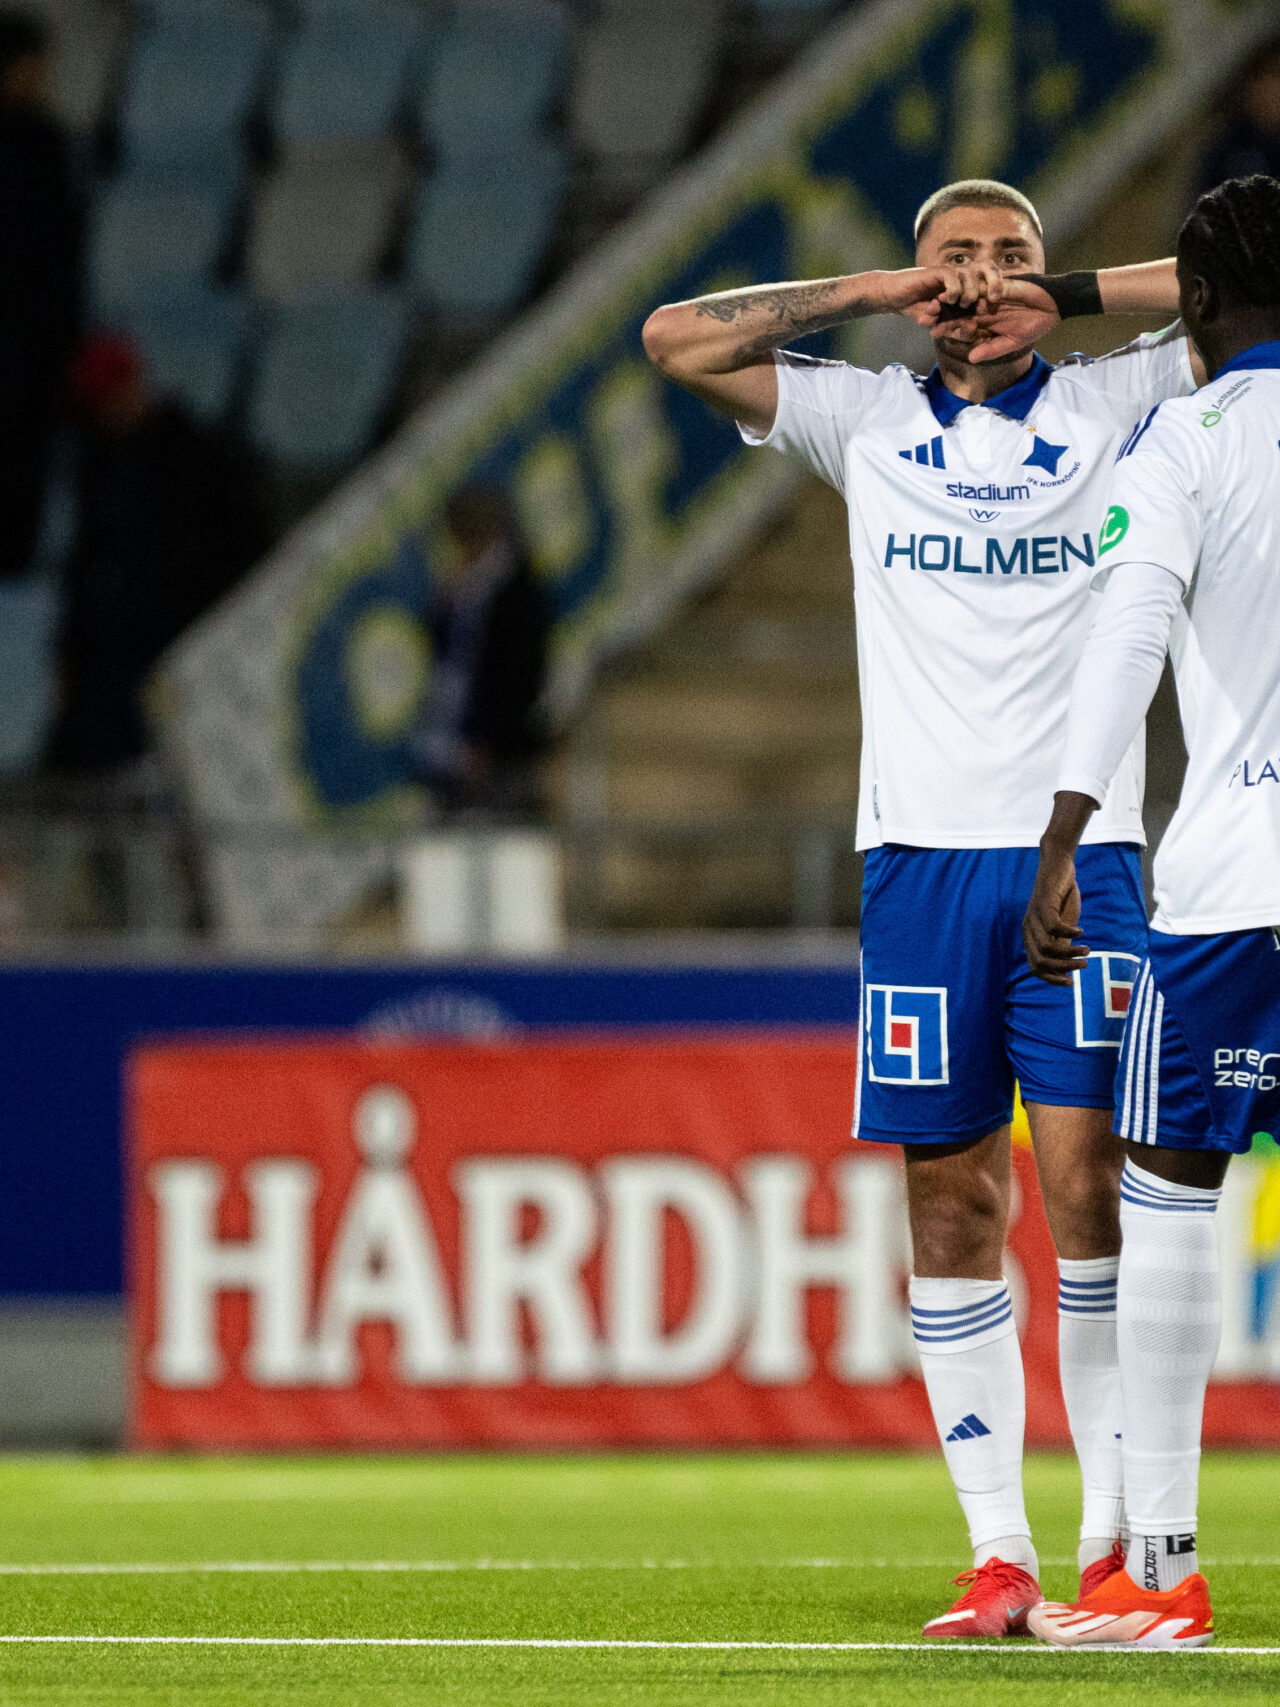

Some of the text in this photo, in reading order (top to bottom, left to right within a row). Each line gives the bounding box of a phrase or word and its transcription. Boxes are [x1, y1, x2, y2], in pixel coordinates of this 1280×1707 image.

[946, 481, 1030, 500] stadium
[884, 533, 1096, 575] HOLMEN
[1214, 1048, 1261, 1069] pre
[1214, 1070, 1277, 1091] zero
